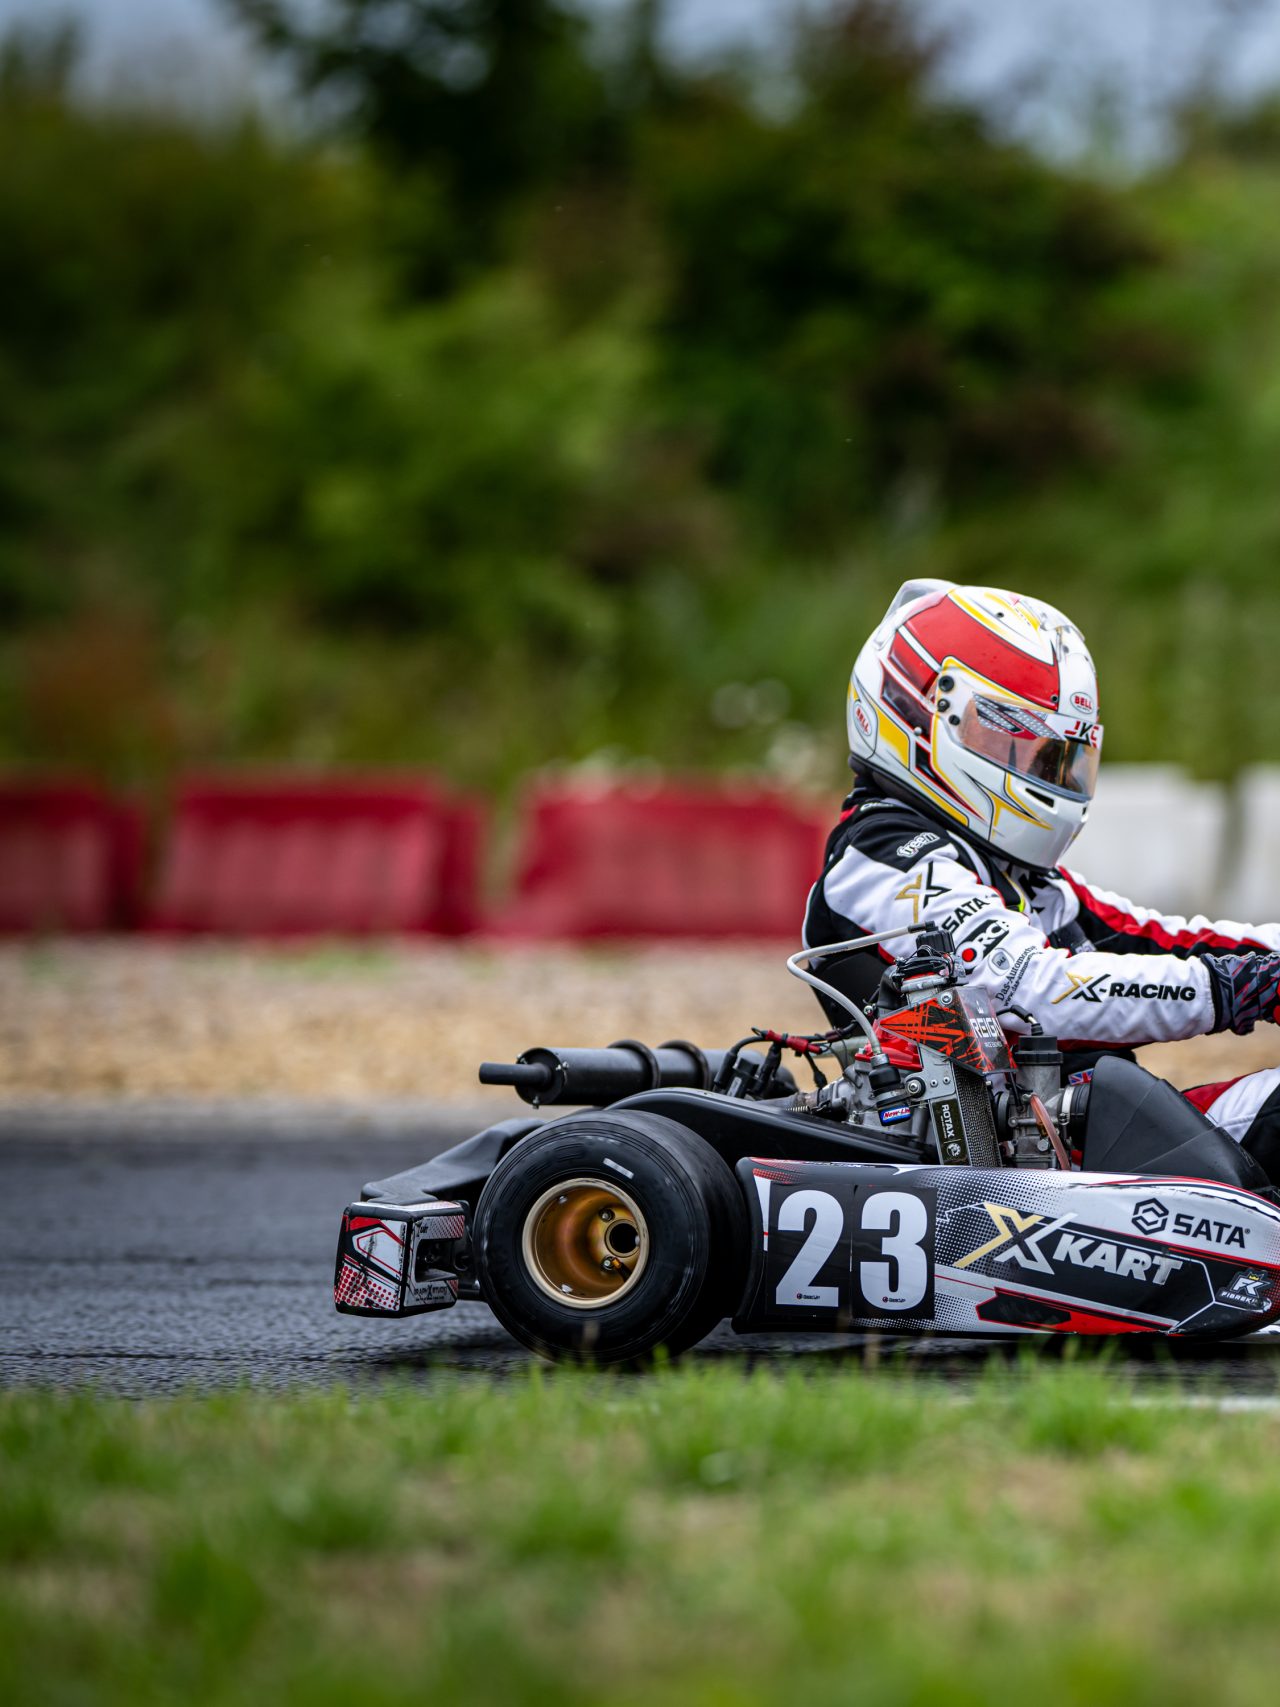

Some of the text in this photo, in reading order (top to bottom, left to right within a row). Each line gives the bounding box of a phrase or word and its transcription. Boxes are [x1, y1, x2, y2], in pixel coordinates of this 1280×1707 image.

[1074, 695, 1092, 709] BELL
[856, 707, 869, 733] BELL
[897, 832, 940, 858] freem
[941, 897, 990, 934] SATA
[883, 1106, 911, 1120] New-Lin
[941, 1104, 955, 1139] ROTAX
[775, 1189, 929, 1311] 23
[1052, 1233, 1184, 1286] KART
[1221, 1290, 1258, 1305] FIBREKI
